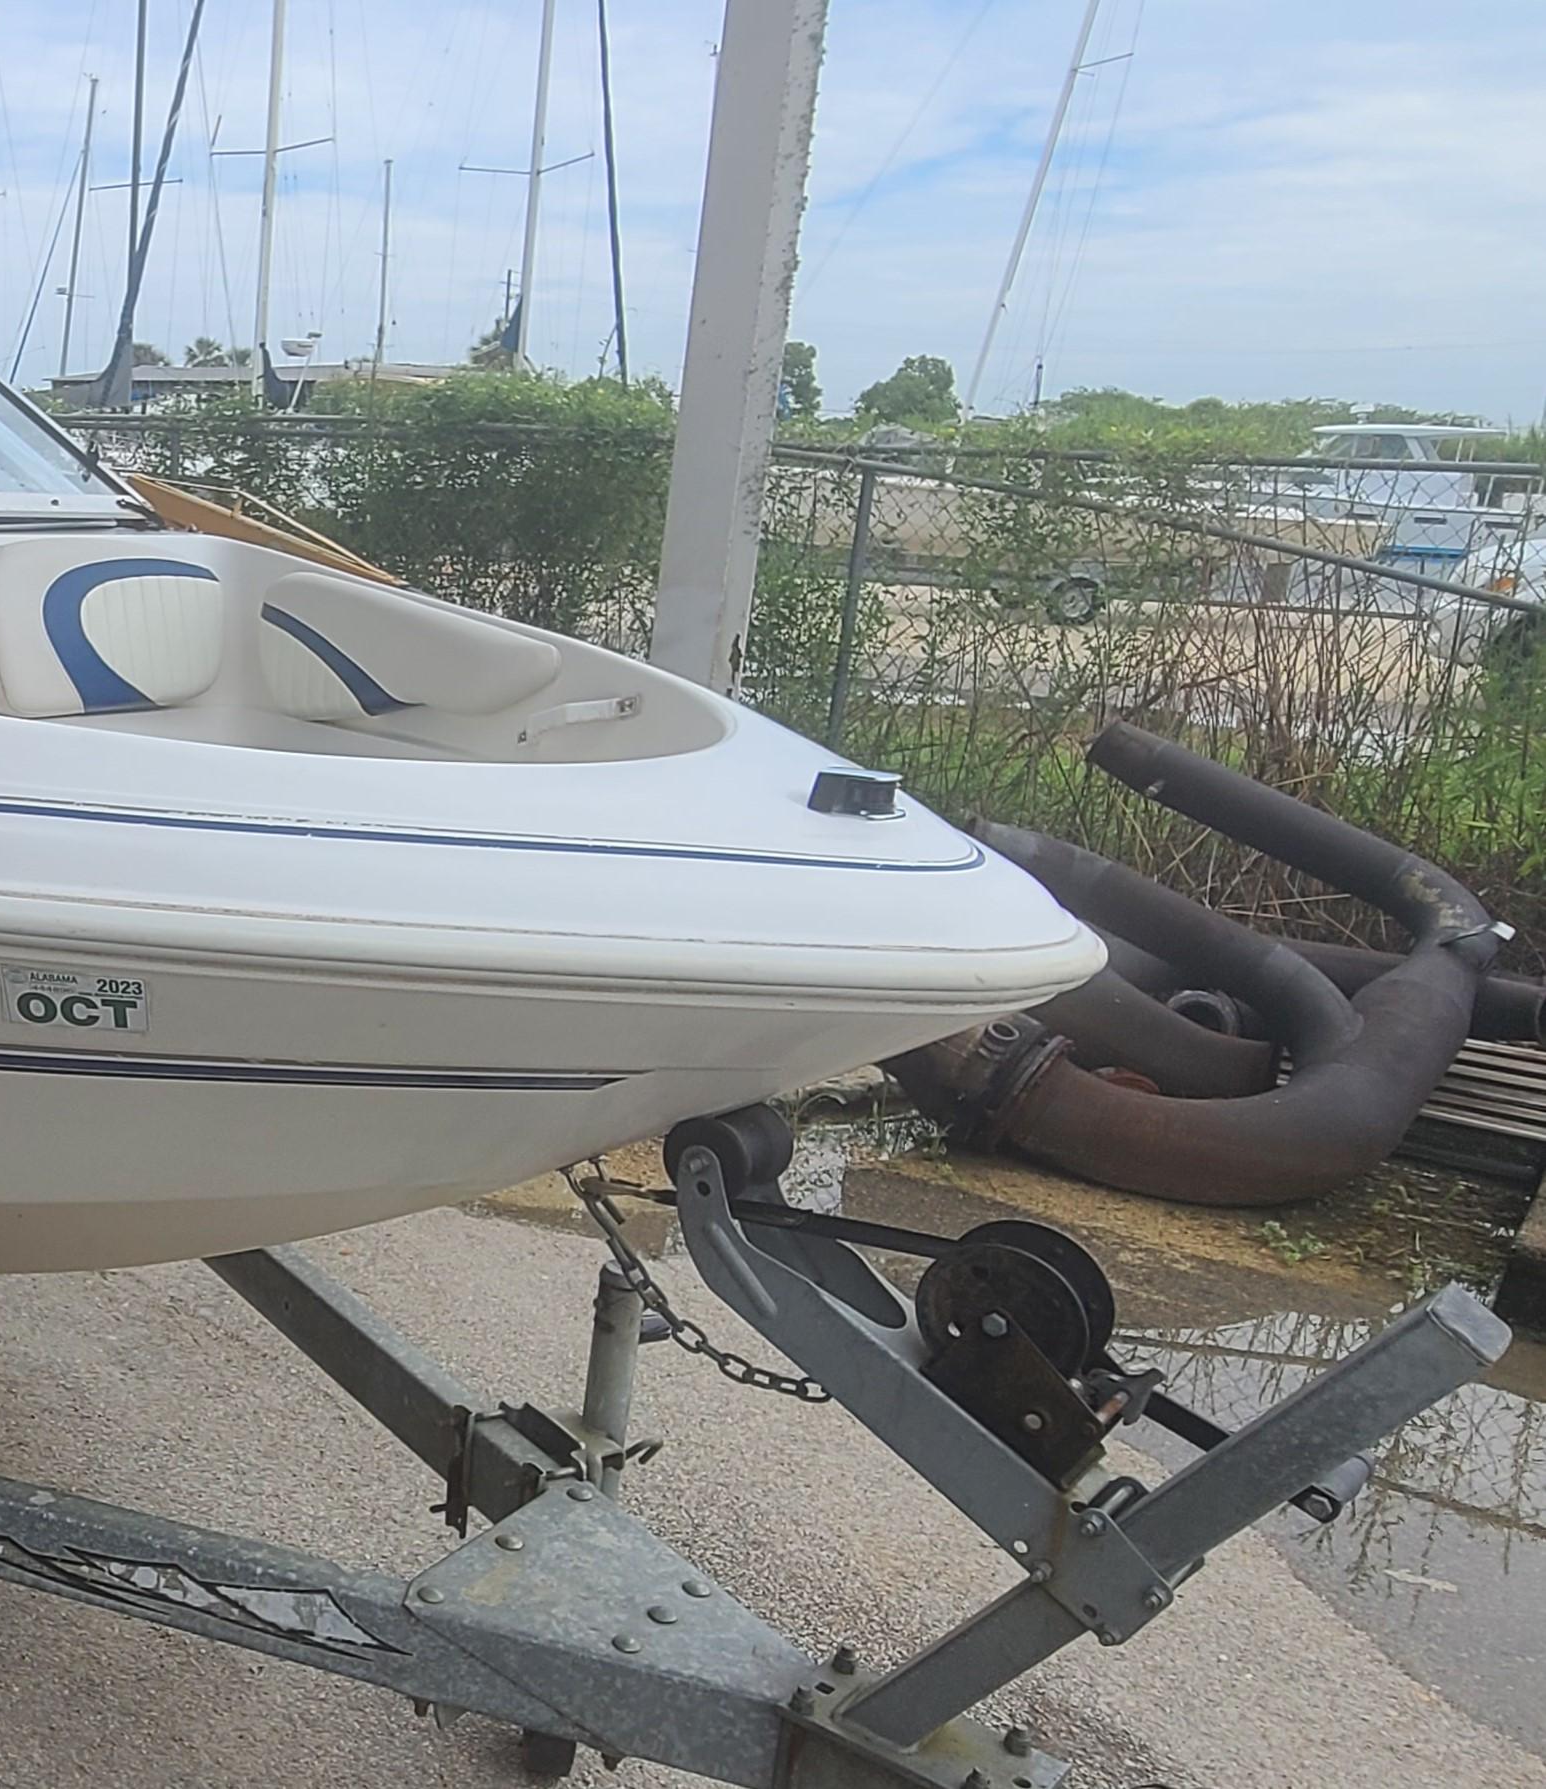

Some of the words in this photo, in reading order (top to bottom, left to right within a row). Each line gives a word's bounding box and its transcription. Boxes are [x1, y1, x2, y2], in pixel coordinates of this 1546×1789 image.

[30, 971, 79, 985] ALABAMA
[96, 978, 144, 995] 2023
[16, 991, 138, 1029] OCT
